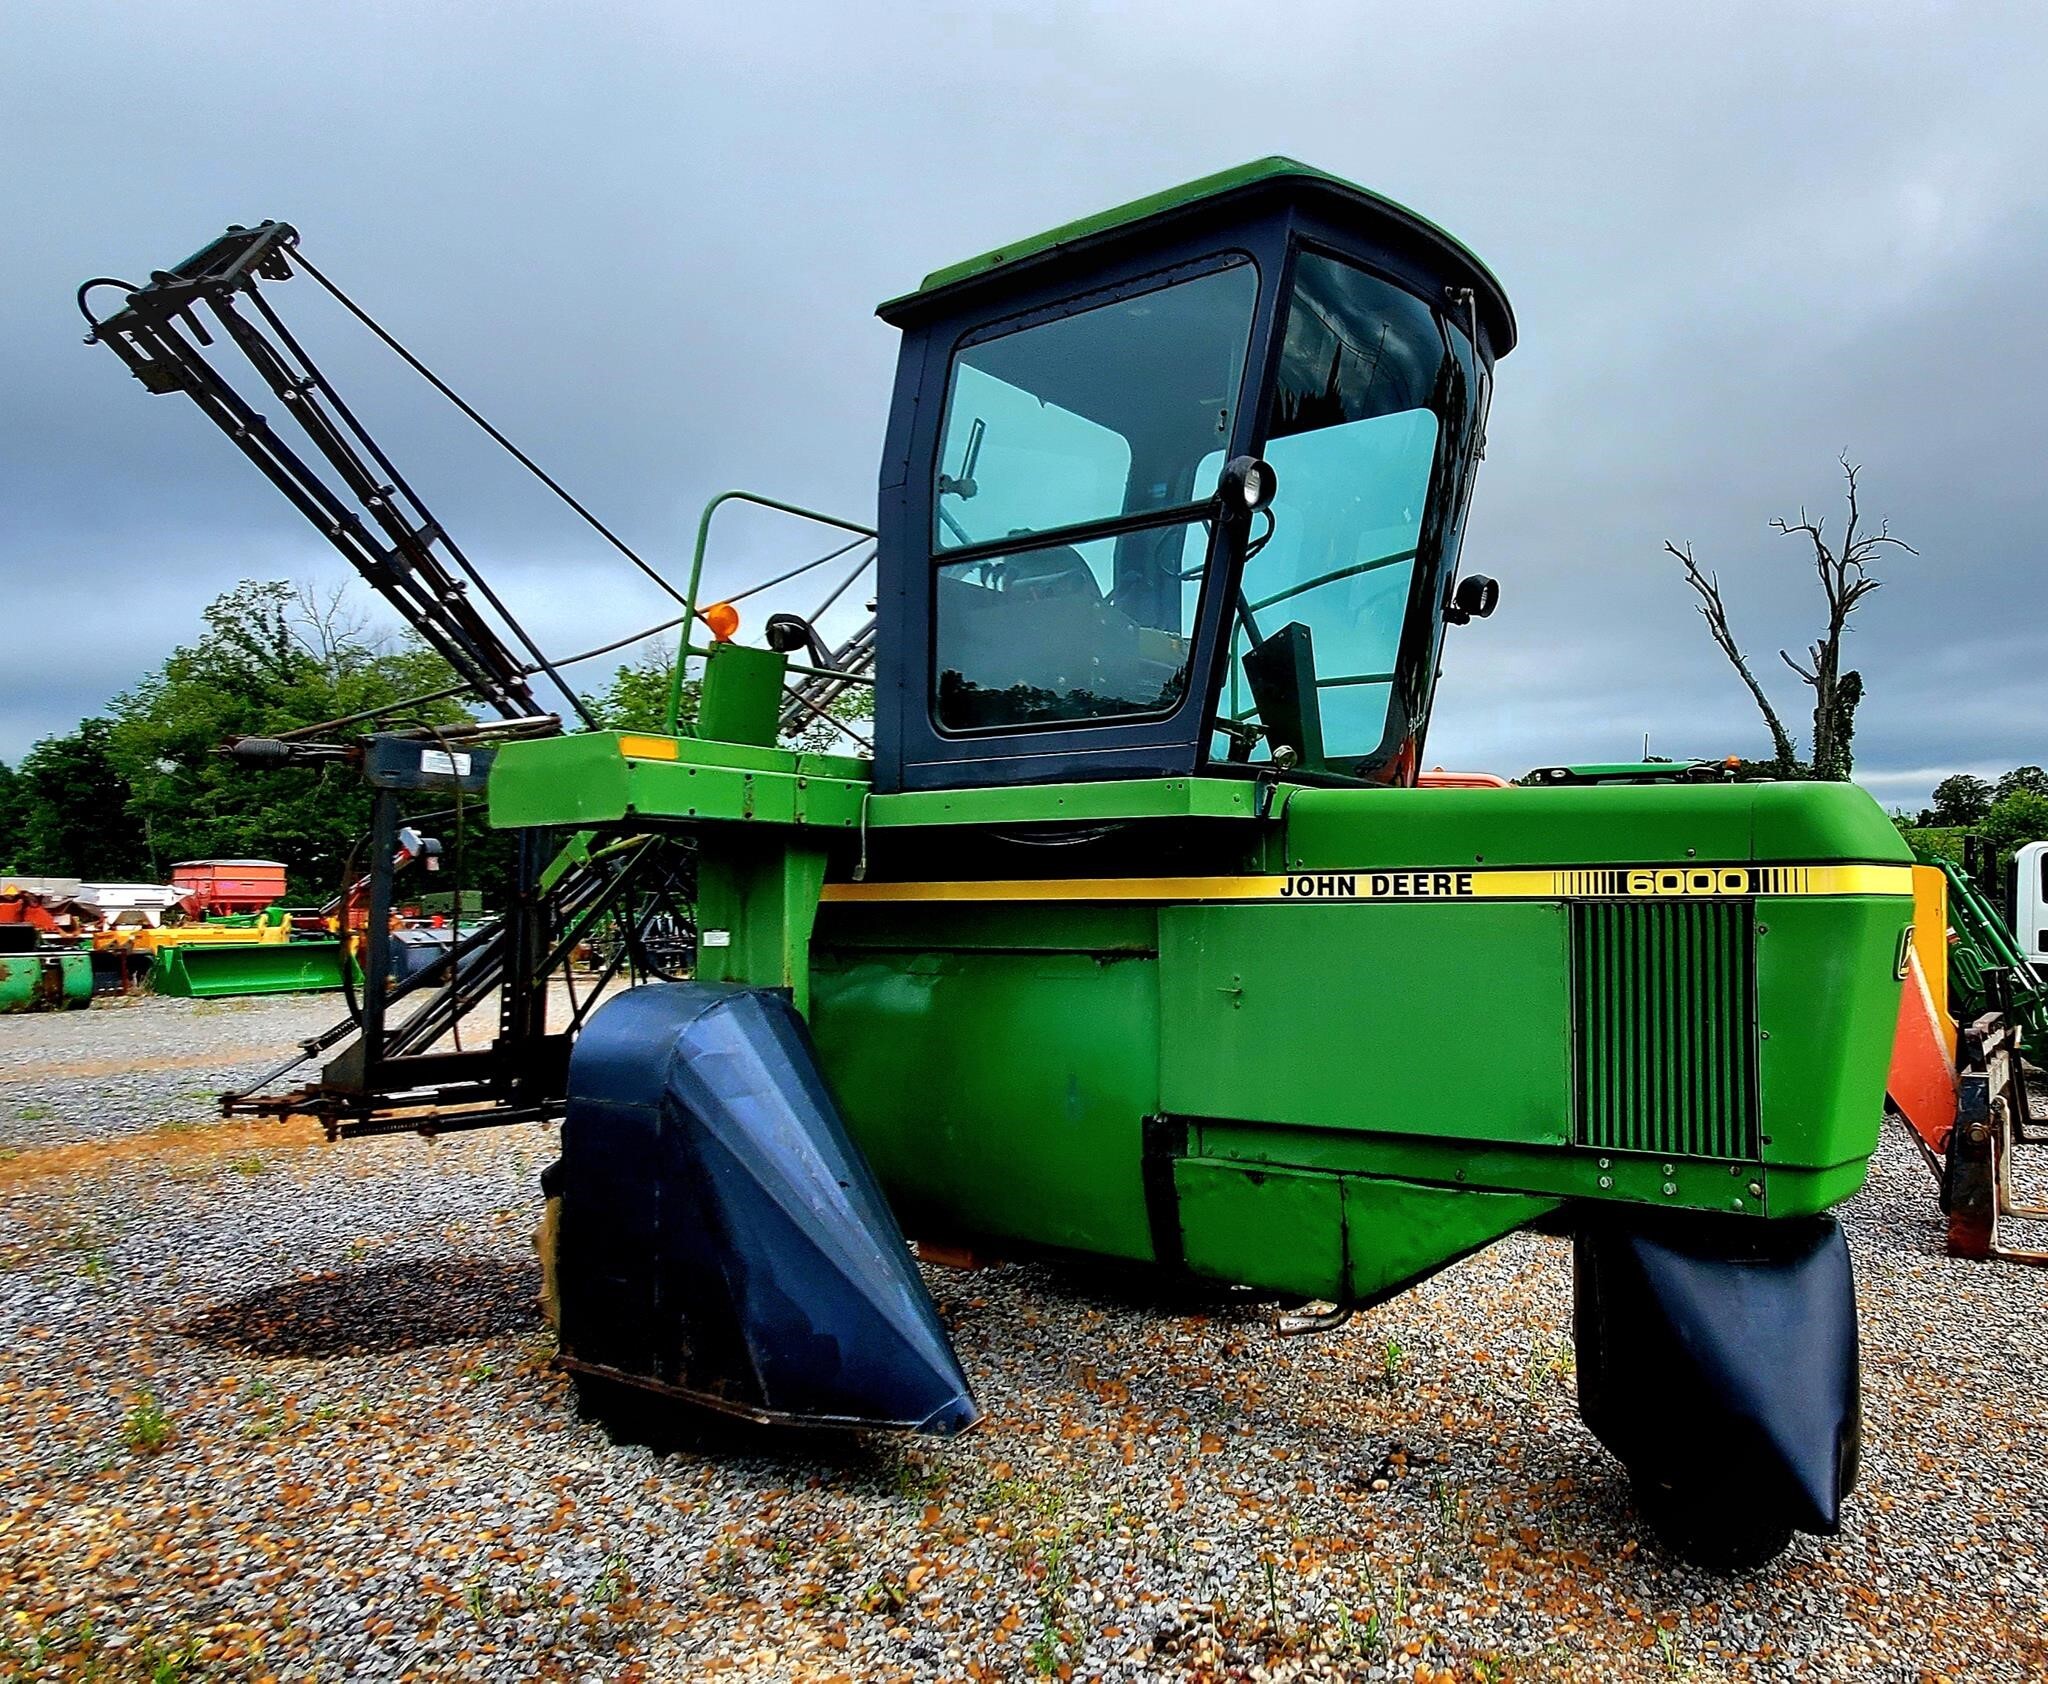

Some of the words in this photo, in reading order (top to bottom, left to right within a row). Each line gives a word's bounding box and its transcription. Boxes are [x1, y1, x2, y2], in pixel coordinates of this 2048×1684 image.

[1280, 876, 1356, 896] JOHN
[1371, 873, 1473, 896] DEERE
[1627, 868, 1749, 895] 6000
